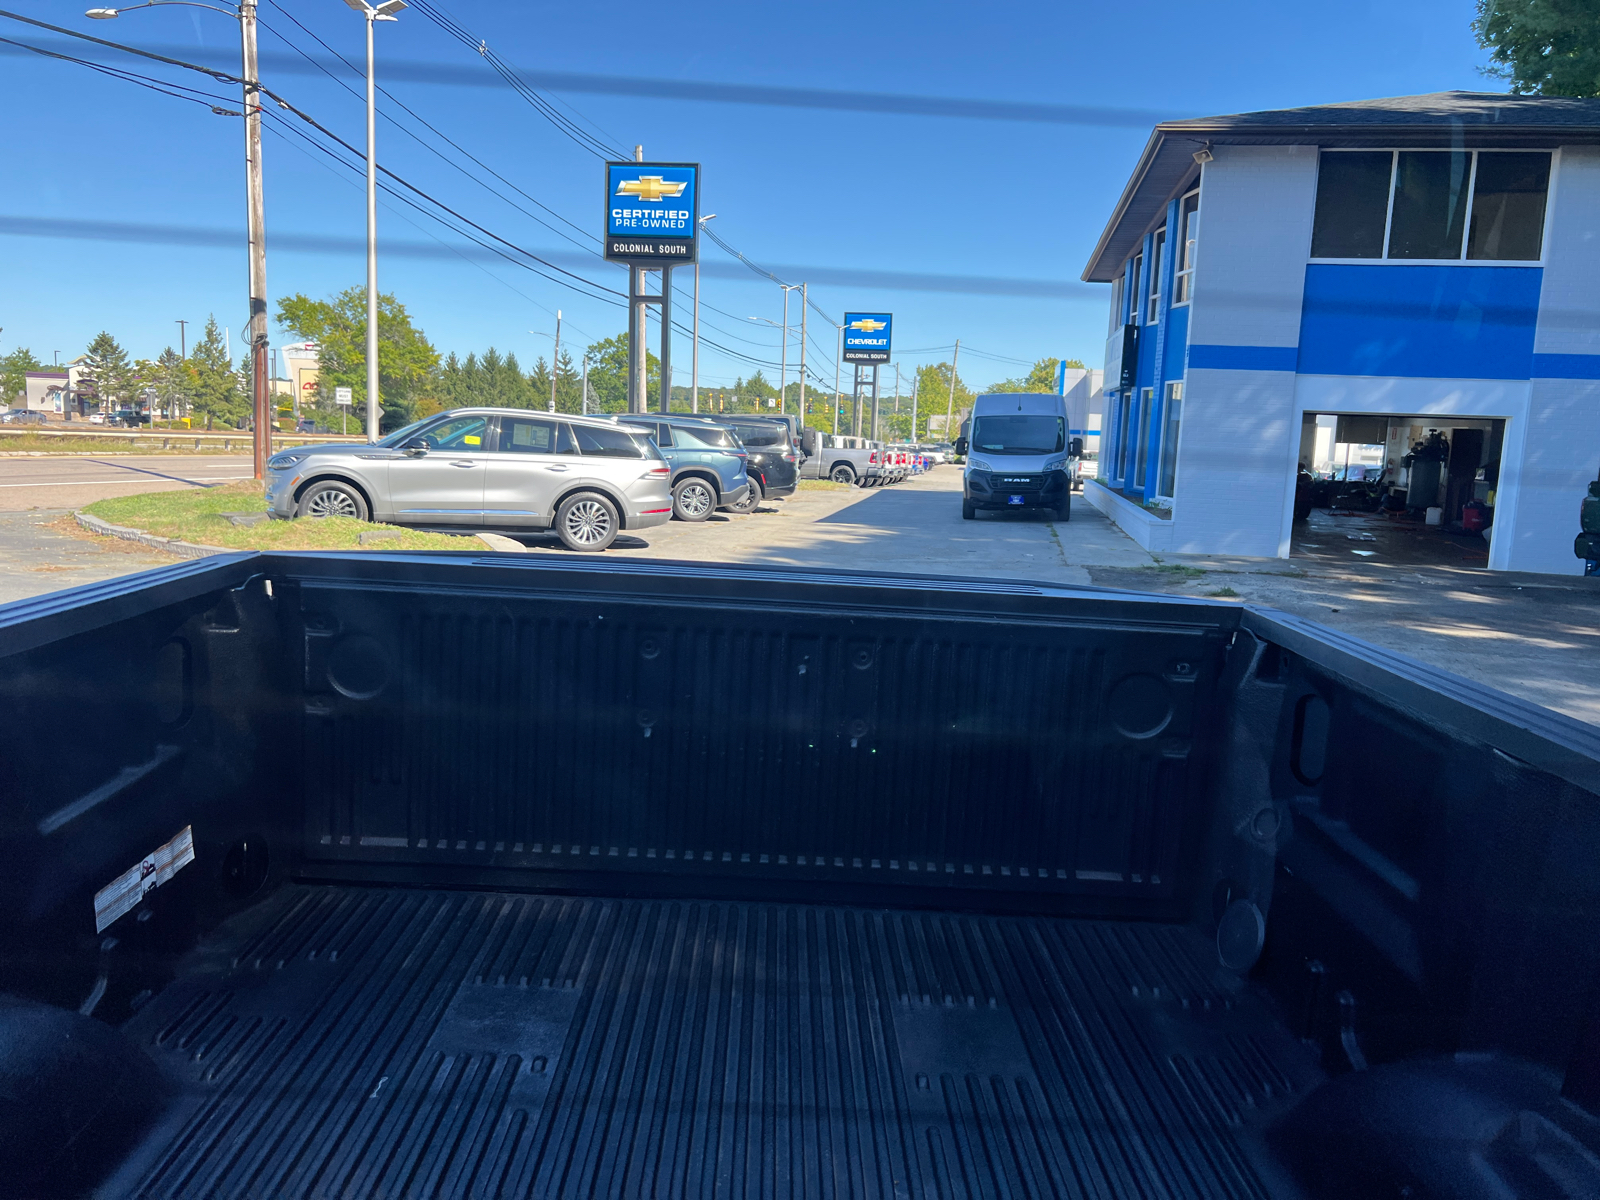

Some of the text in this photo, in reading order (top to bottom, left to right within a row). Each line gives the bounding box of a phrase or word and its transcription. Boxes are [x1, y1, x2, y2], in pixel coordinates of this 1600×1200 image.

[612, 209, 689, 219] CERTIFIED
[616, 219, 685, 228] PRE-OWNED
[613, 244, 686, 254] COLONIAL SOUTH
